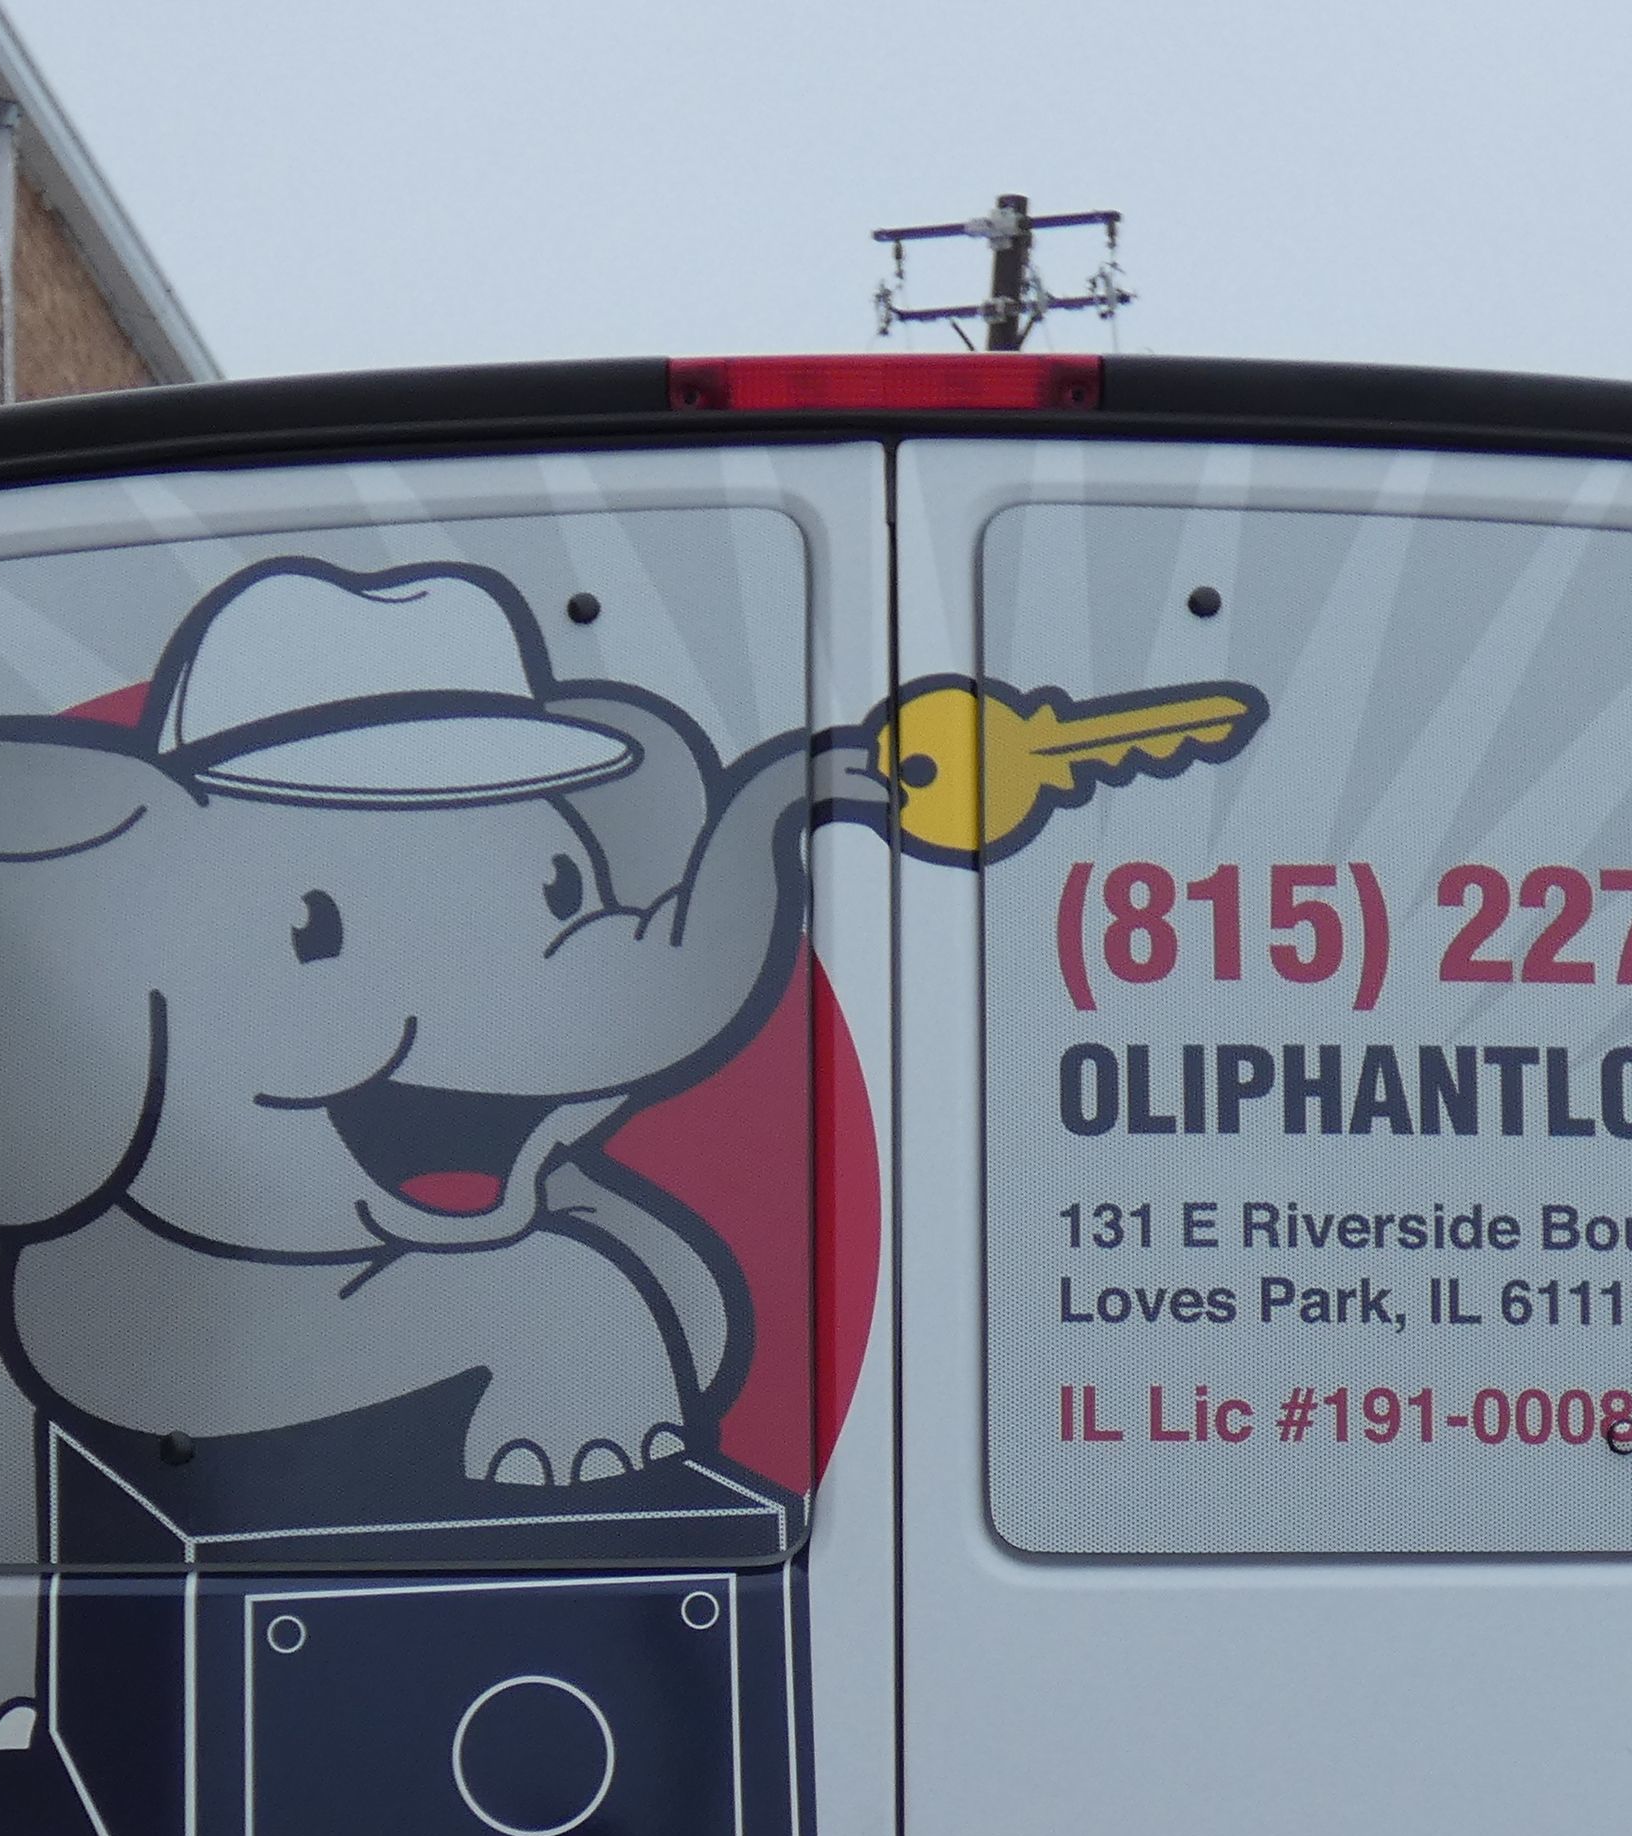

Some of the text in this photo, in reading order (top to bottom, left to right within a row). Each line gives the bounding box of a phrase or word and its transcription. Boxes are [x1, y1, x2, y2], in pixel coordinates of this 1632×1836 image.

[1055, 861, 1390, 1011] (815)
[1059, 1201, 1153, 1250] 131
[1182, 1201, 1220, 1249] E
[1241, 1200, 1521, 1252] Riverside
[1059, 1276, 1237, 1325] Loves
[1259, 1275, 1407, 1335] Park,
[1430, 1277, 1482, 1326] IL
[1059, 1386, 1123, 1442] IL
[1148, 1384, 1252, 1442] Lic
